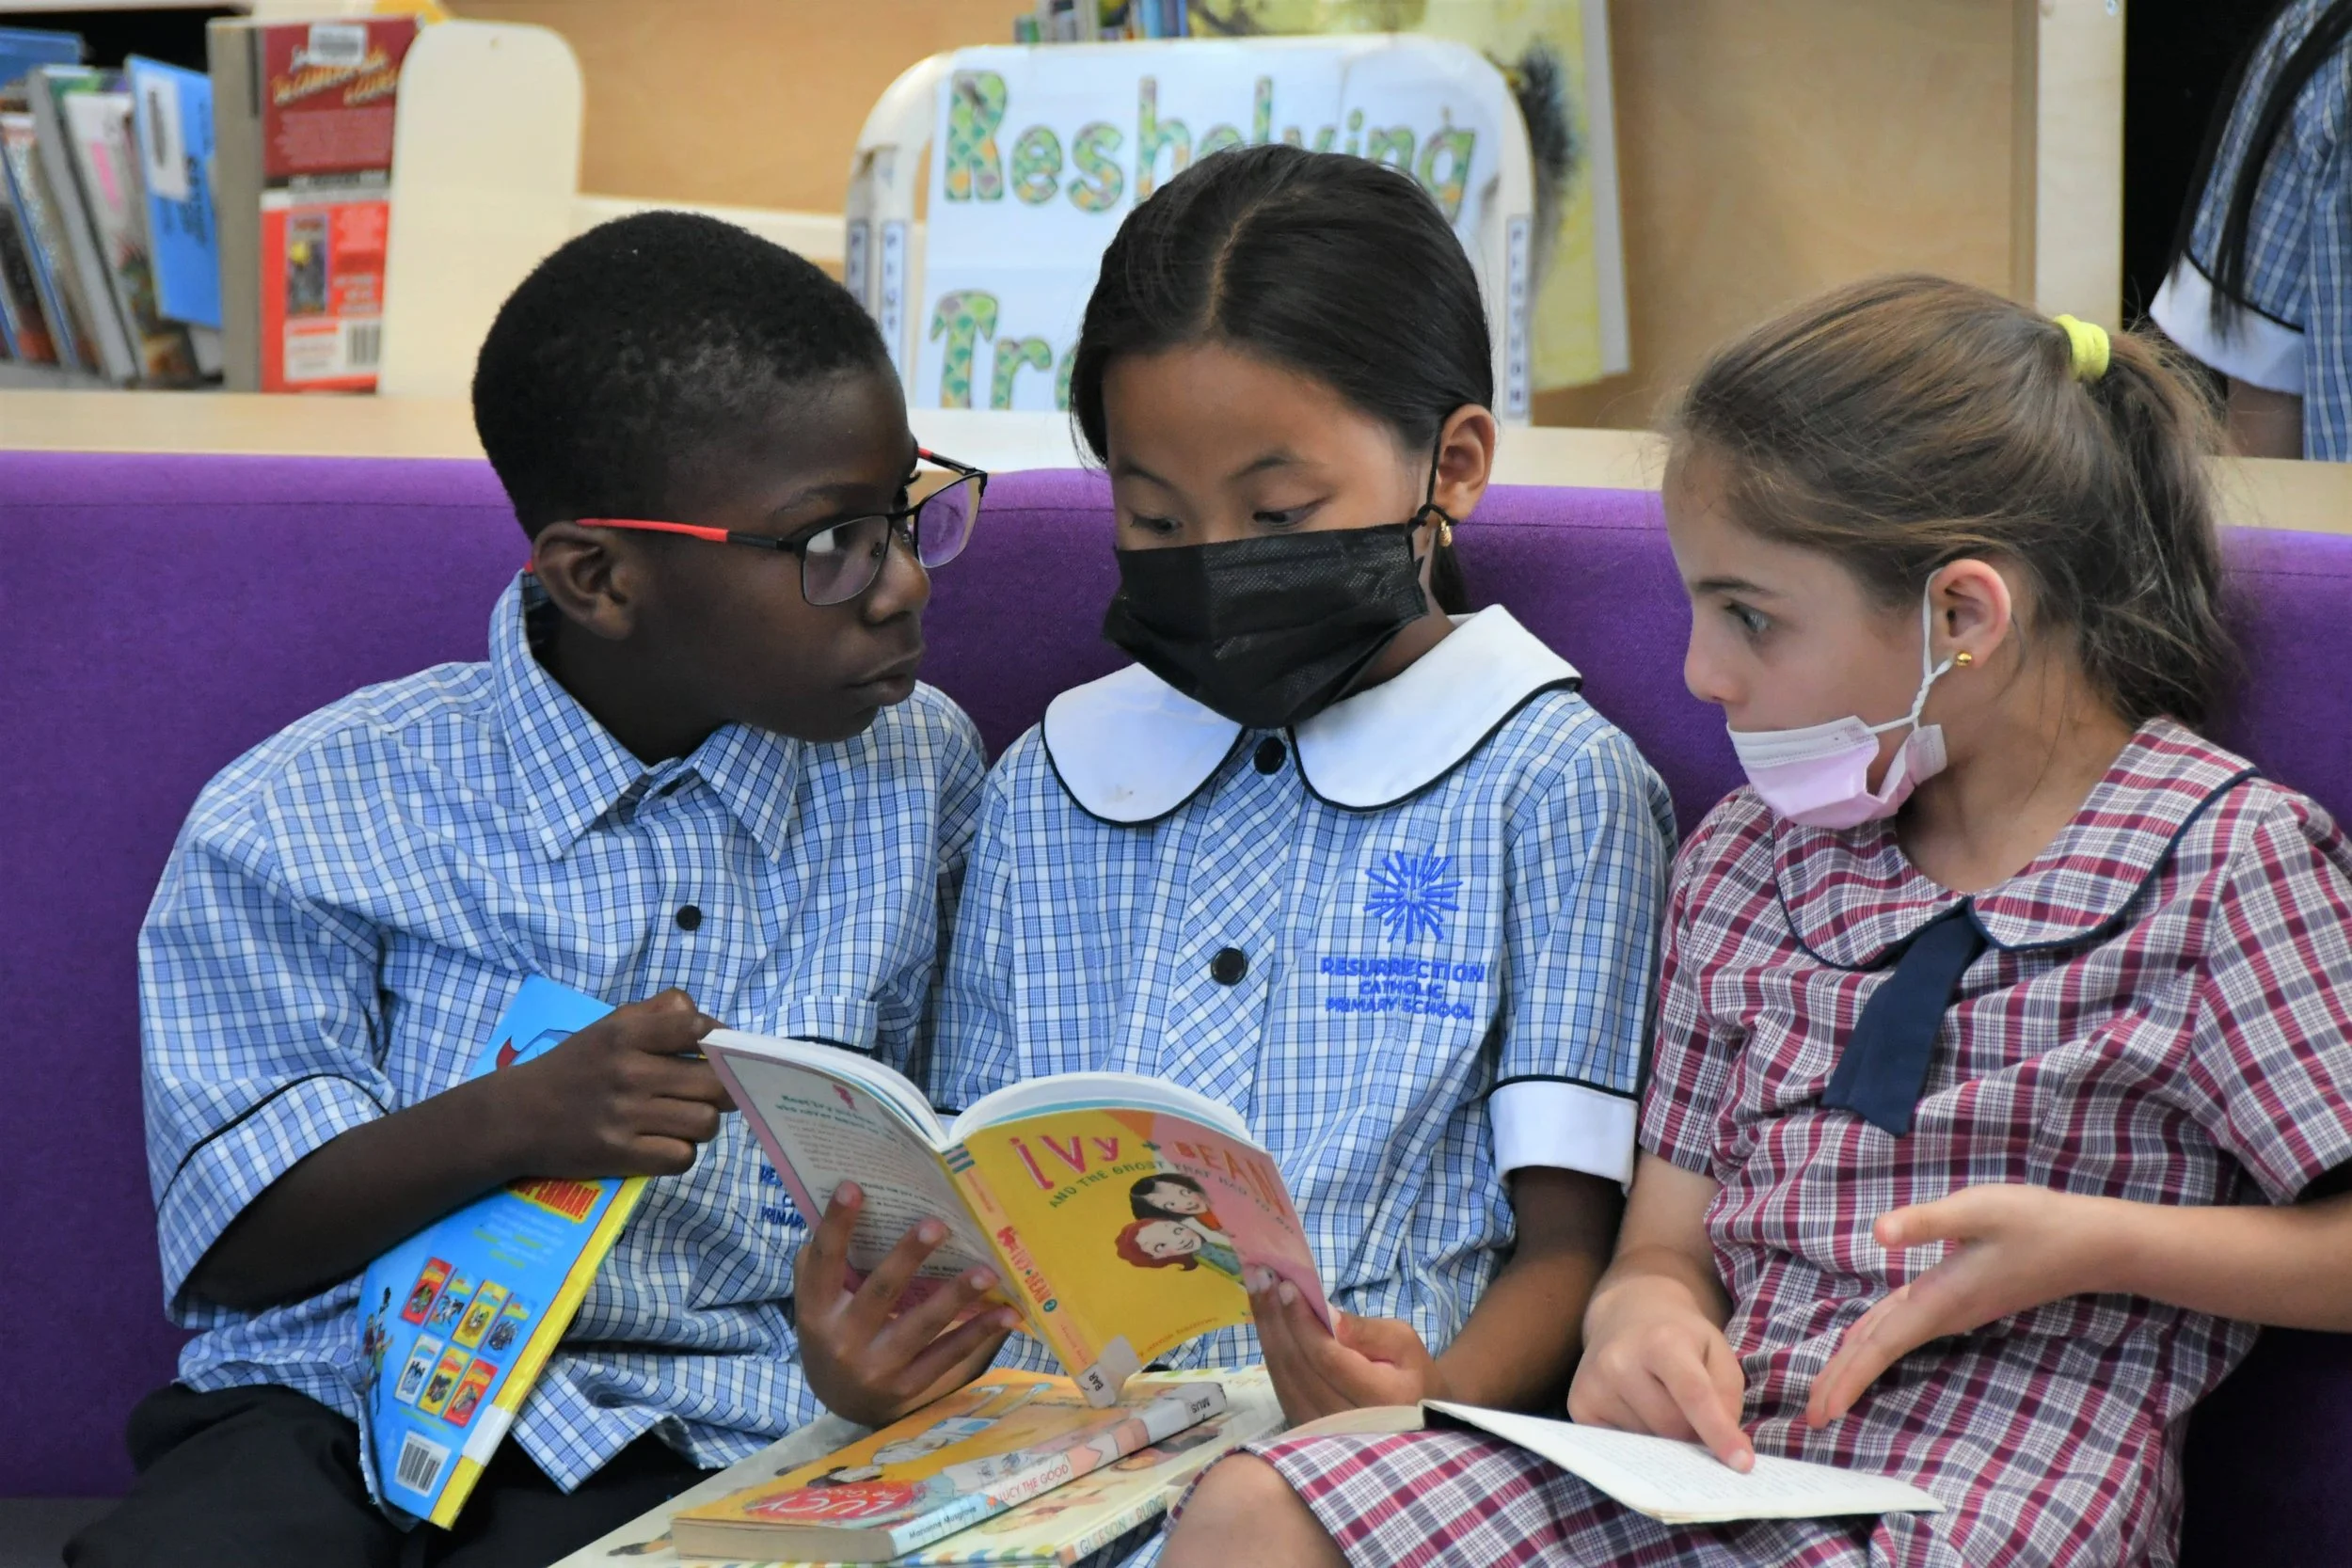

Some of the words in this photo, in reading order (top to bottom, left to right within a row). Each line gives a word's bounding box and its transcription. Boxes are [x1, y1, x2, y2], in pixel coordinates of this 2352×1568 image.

[1320, 957, 1486, 982] RESURRECTION
[1359, 980, 1444, 999] CATHOLIC
[1326, 997, 1398, 1013] PRIMARY
[1402, 998, 1475, 1021] SCHOOL
[1049, 1185, 1077, 1208] AND
[1077, 1170, 1108, 1187] THE
[1025, 1272, 1052, 1304] BEAN
[1089, 1371, 1104, 1392] BAR
[1190, 1396, 1211, 1414] MUS
[998, 1483, 1021, 1504] LUCY
[1022, 1478, 1039, 1494] THE
[1040, 1464, 1070, 1485] GOOD
[746, 1496, 896, 1517] LUCY
[909, 1519, 943, 1540] Marianne
[944, 1506, 977, 1528] Musgrove
